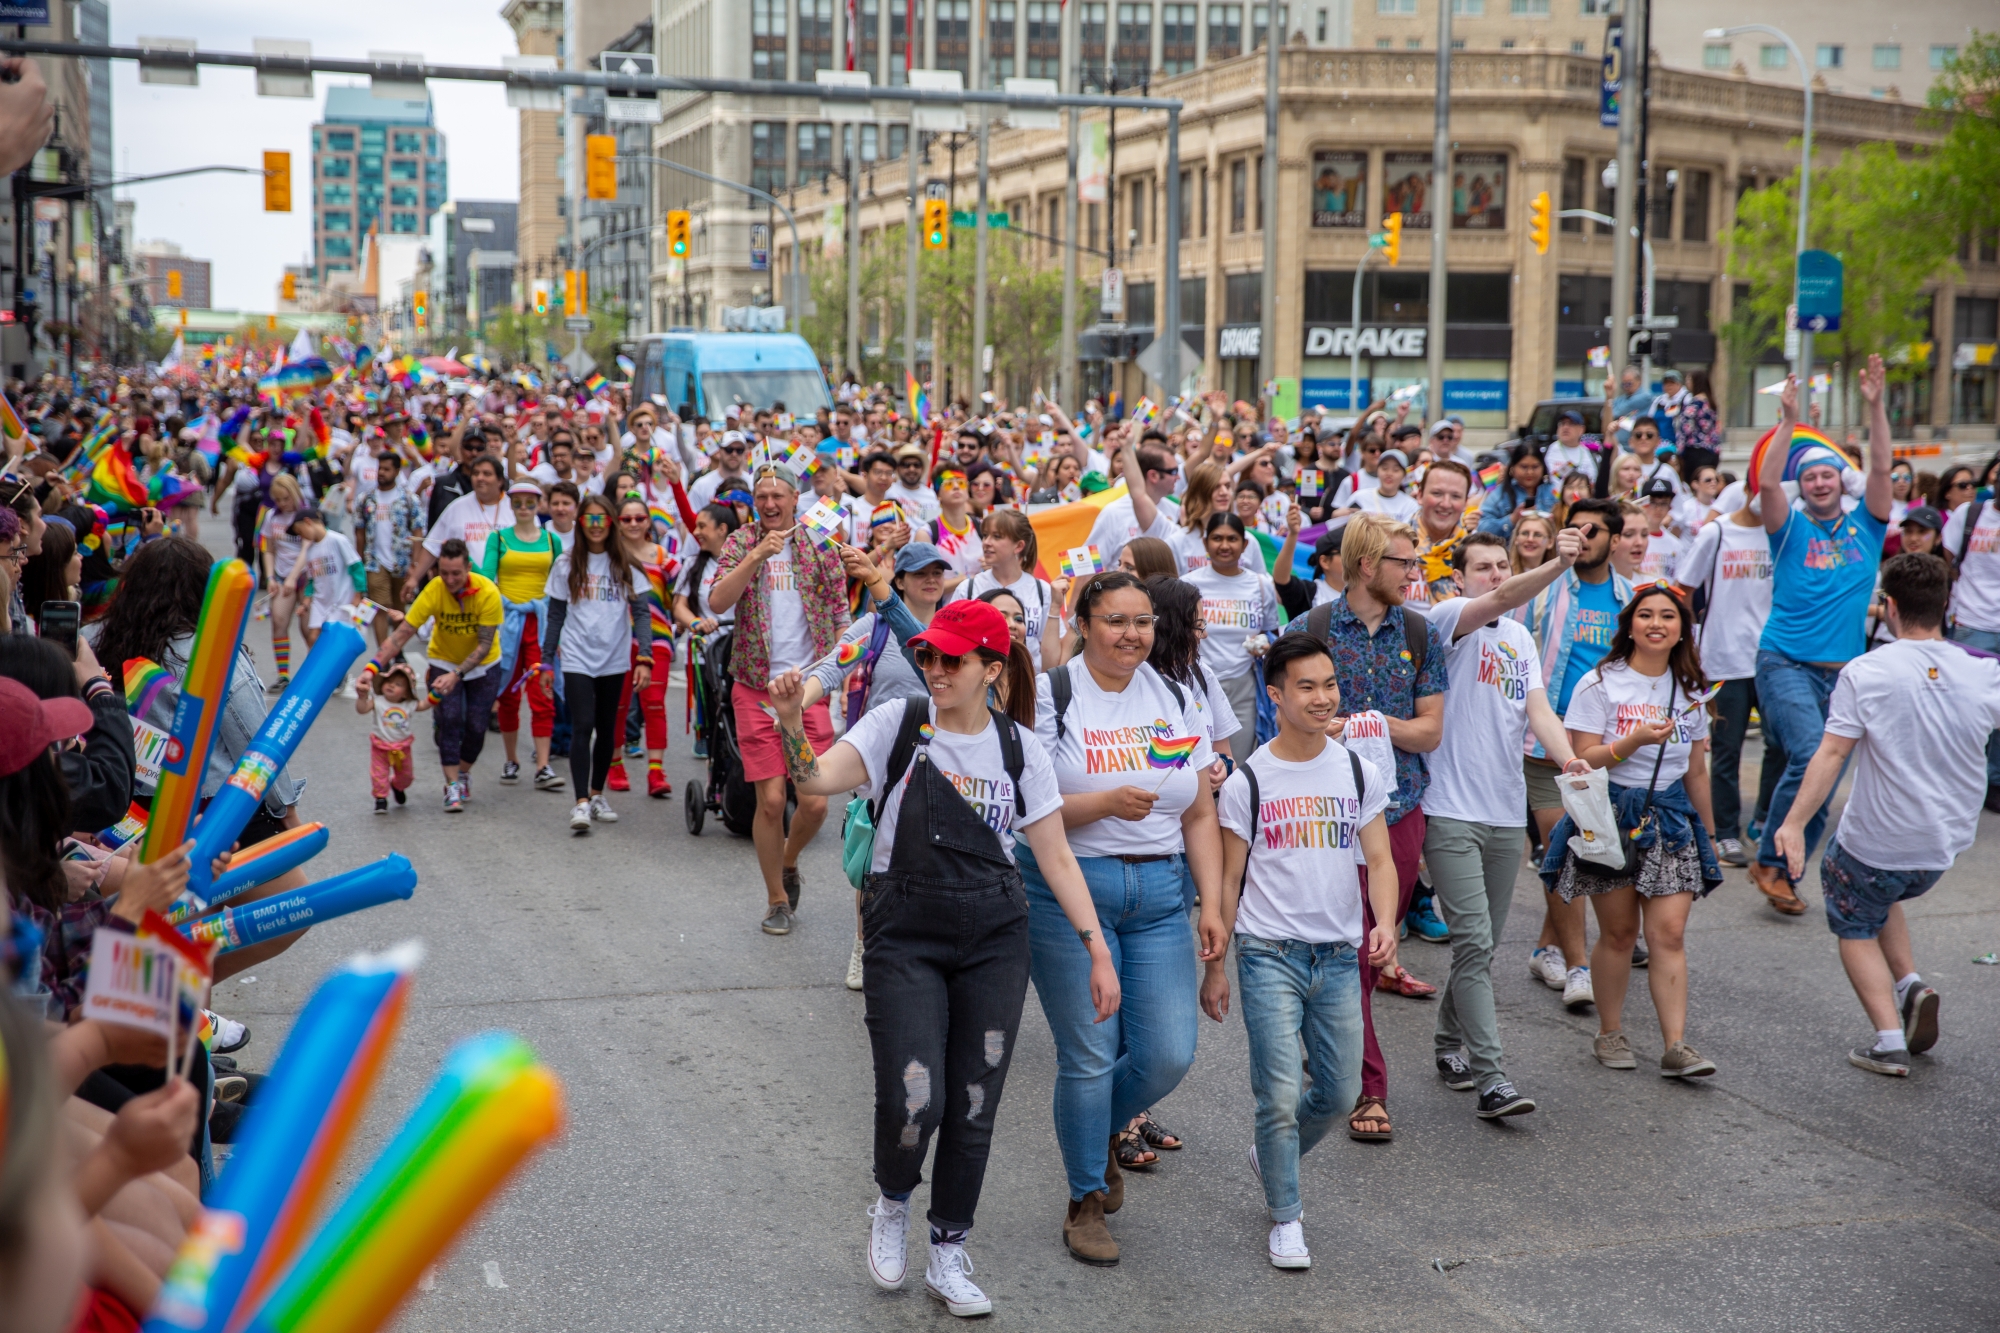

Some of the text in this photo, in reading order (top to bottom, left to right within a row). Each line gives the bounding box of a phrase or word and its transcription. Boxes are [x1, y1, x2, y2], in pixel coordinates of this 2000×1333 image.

[1220, 327, 1261, 357] DRAKE
[1305, 327, 1427, 356] DRAKE
[1722, 563, 1772, 580] MANITOB
[266, 694, 300, 739] BMO Pride
[278, 698, 313, 746] Fierté BMO
[230, 751, 262, 788] Pride
[1260, 796, 1358, 824] UNIVERSITY OF
[1263, 820, 1356, 850] MANITOBA
[211, 880, 255, 904] BMO Pride
[252, 895, 306, 919] BMO Pride
[256, 907, 314, 933] Fierté BMO
[192, 917, 233, 941] Pride
